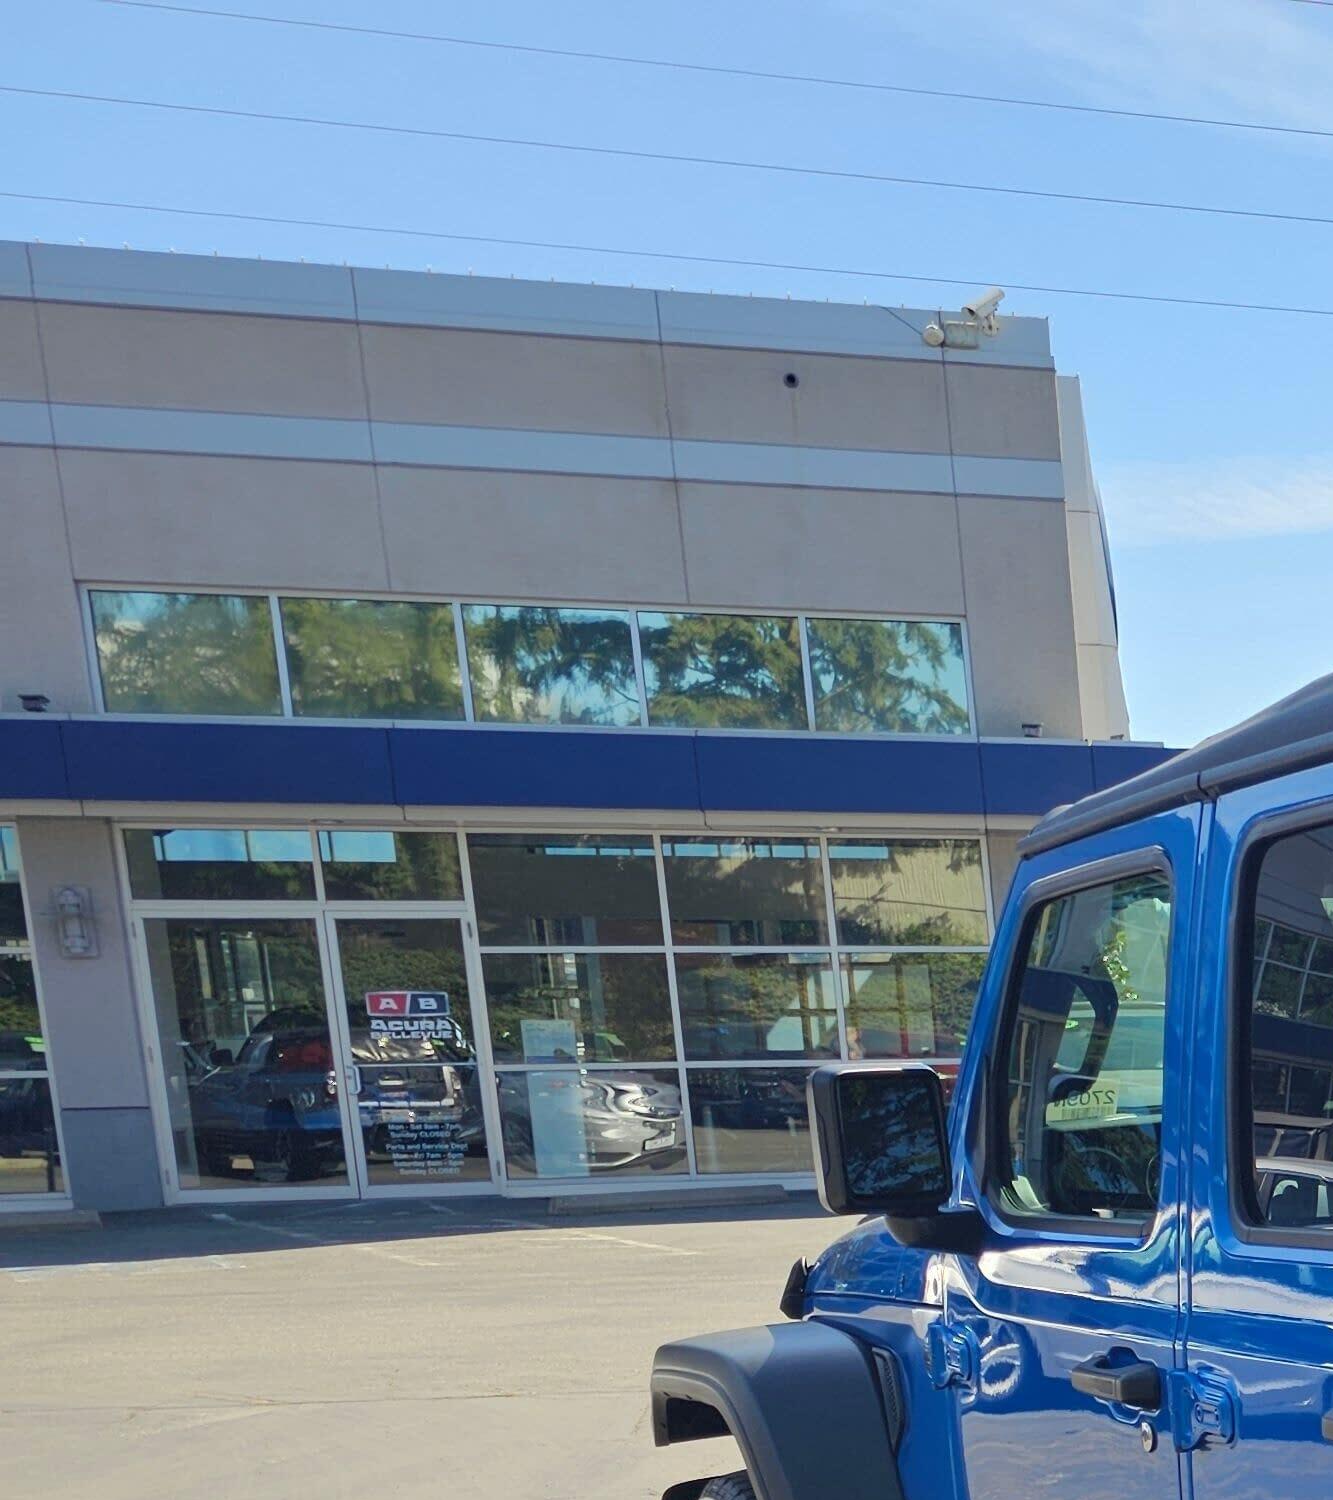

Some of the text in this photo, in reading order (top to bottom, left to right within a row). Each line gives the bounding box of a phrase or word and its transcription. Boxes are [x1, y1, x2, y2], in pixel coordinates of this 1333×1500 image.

[379, 998, 438, 1010] A B
[370, 1020, 453, 1031] ACURA
[370, 1031, 453, 1040] BELLEVUE
[390, 1131, 418, 1140] Sunday
